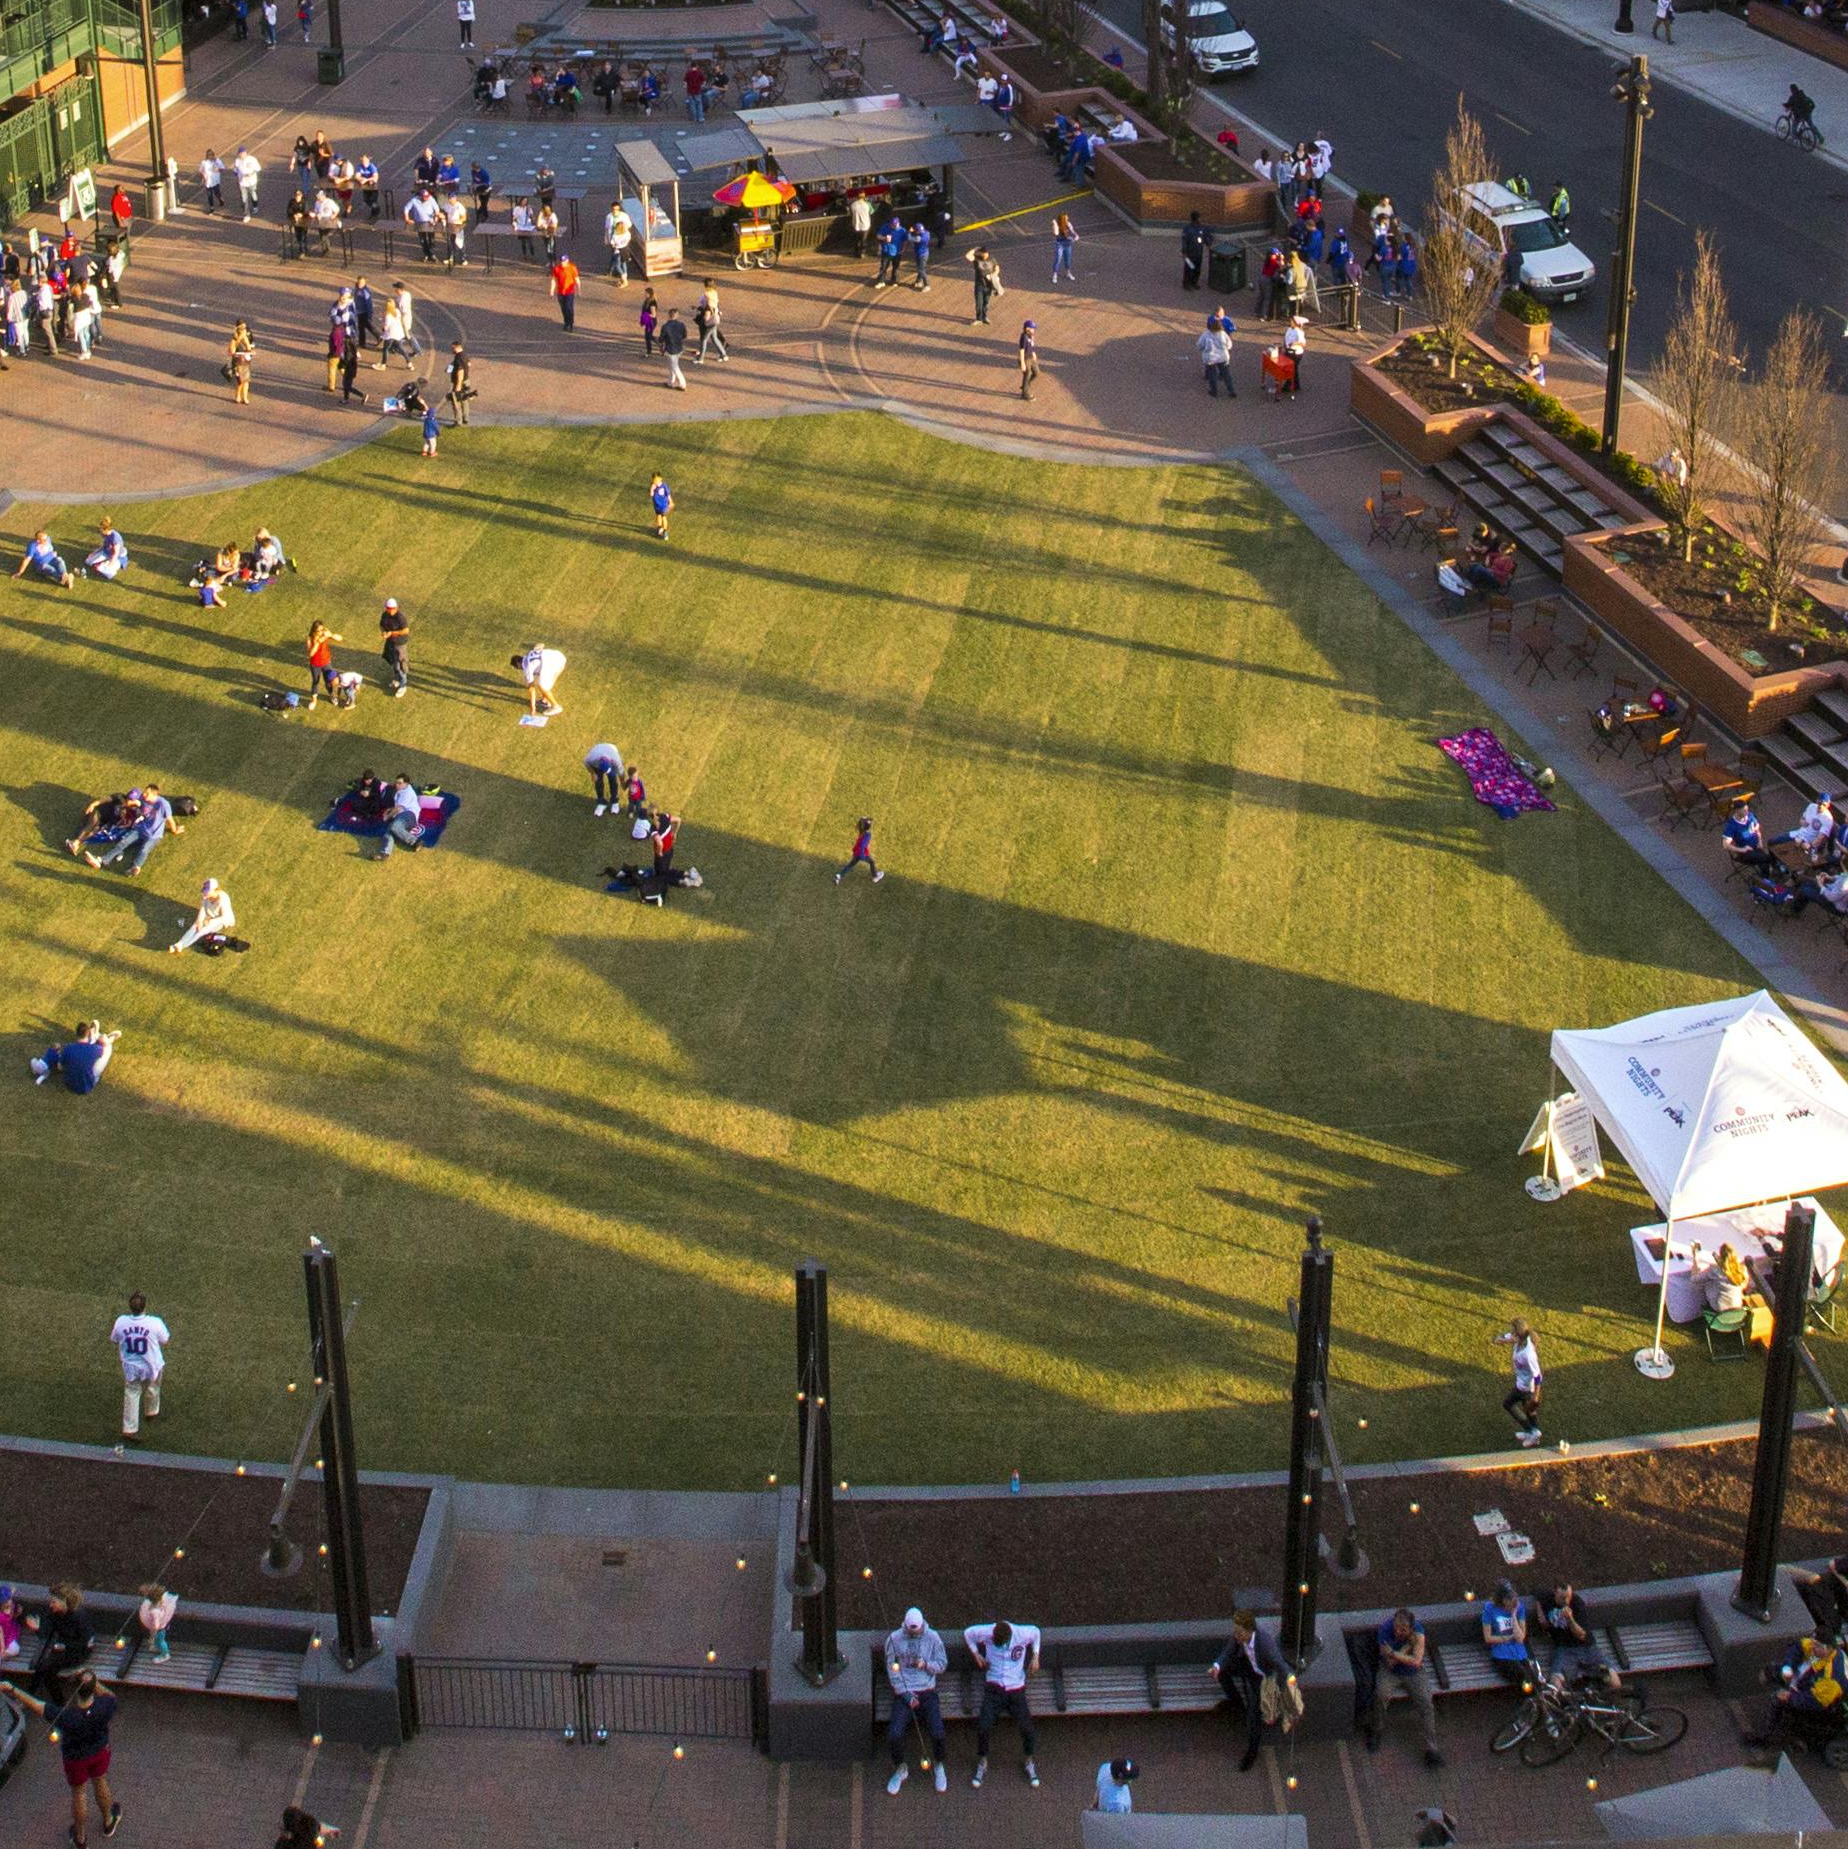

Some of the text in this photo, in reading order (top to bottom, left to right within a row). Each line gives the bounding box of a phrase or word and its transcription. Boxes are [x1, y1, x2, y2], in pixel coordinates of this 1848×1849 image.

[1626, 1068, 1652, 1097] NIGHTS
[1627, 1056, 1666, 1101] COMMUNITY
[1663, 1106, 1686, 1129] PEAK
[1713, 1107, 1815, 1134] COMMUNITY PEAK
[1731, 1123, 1770, 1138] NIGHTS
[125, 1336, 148, 1355] 10
